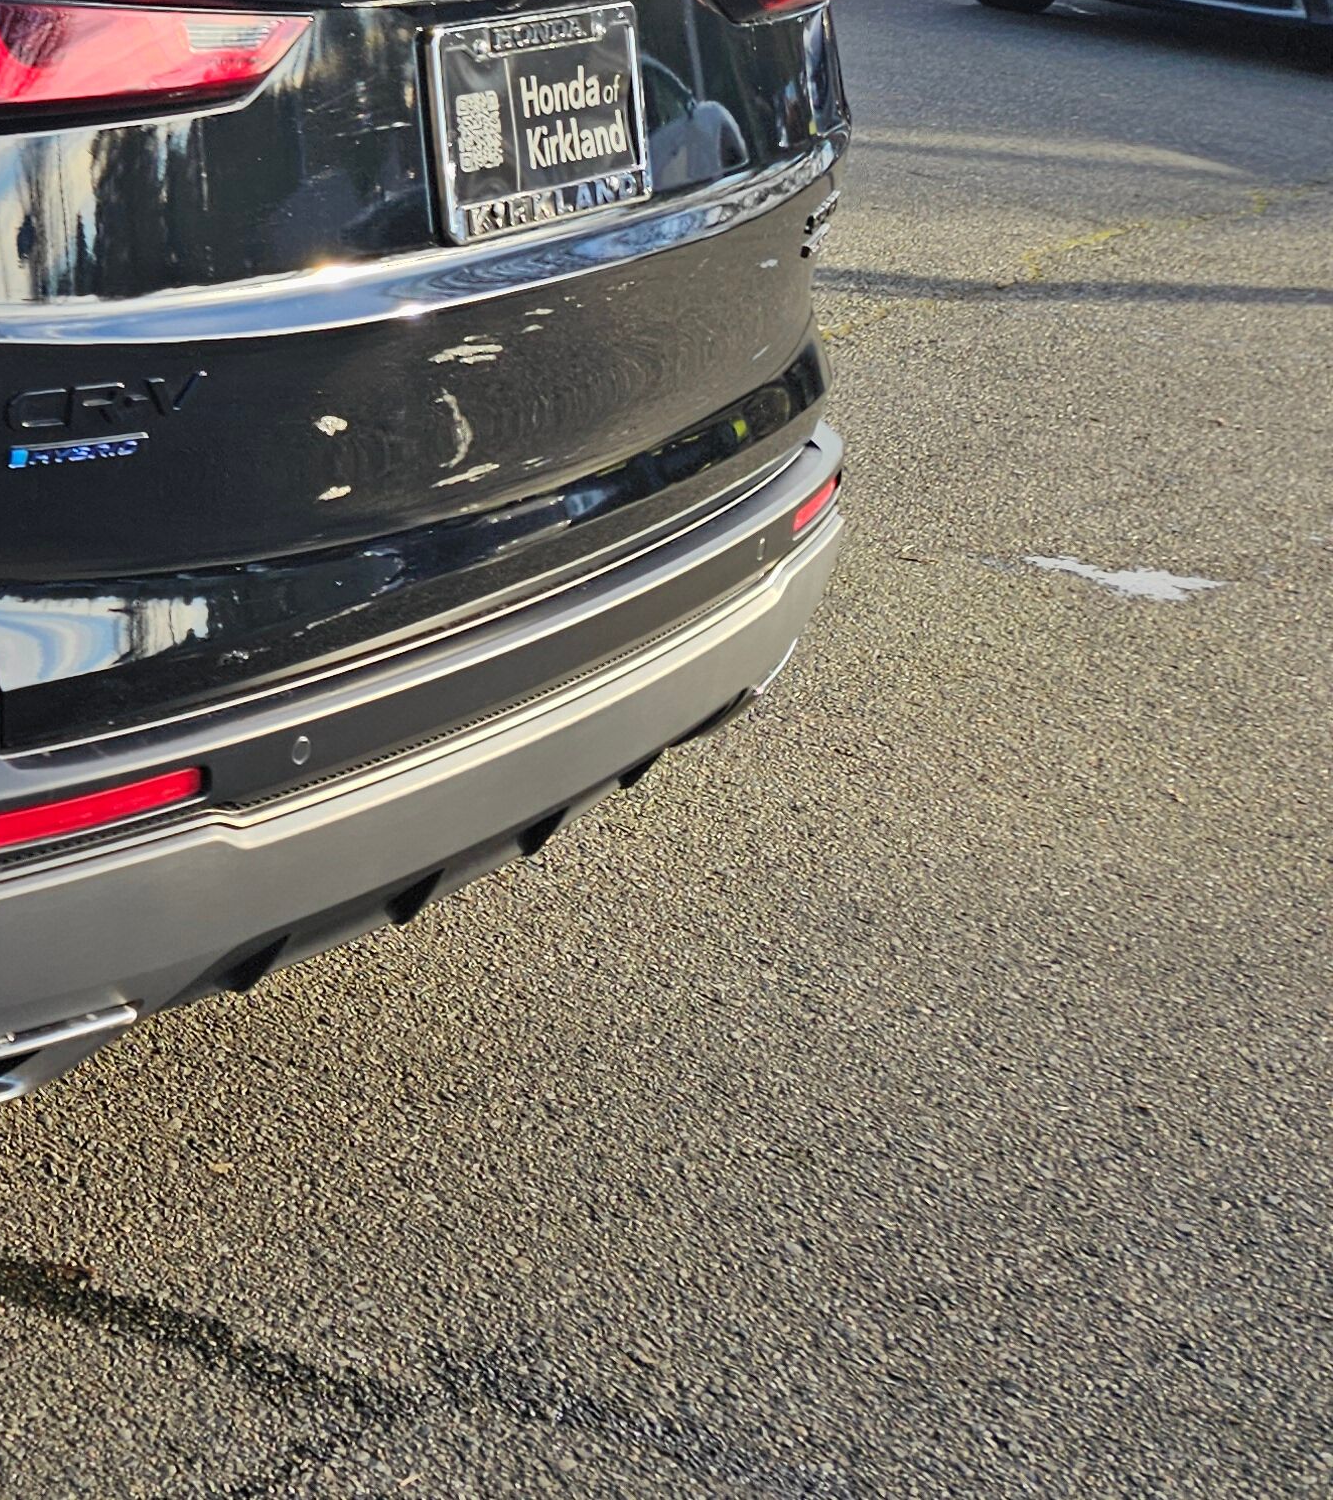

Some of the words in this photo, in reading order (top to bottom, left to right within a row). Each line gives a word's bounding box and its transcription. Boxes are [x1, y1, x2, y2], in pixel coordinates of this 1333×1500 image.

[493, 18, 587, 50] HONDA
[519, 65, 601, 118] Honda
[603, 74, 621, 104] of
[526, 108, 627, 170] Kirkland
[468, 172, 639, 236] KIRKLAND
[2, 369, 209, 431] CR-V
